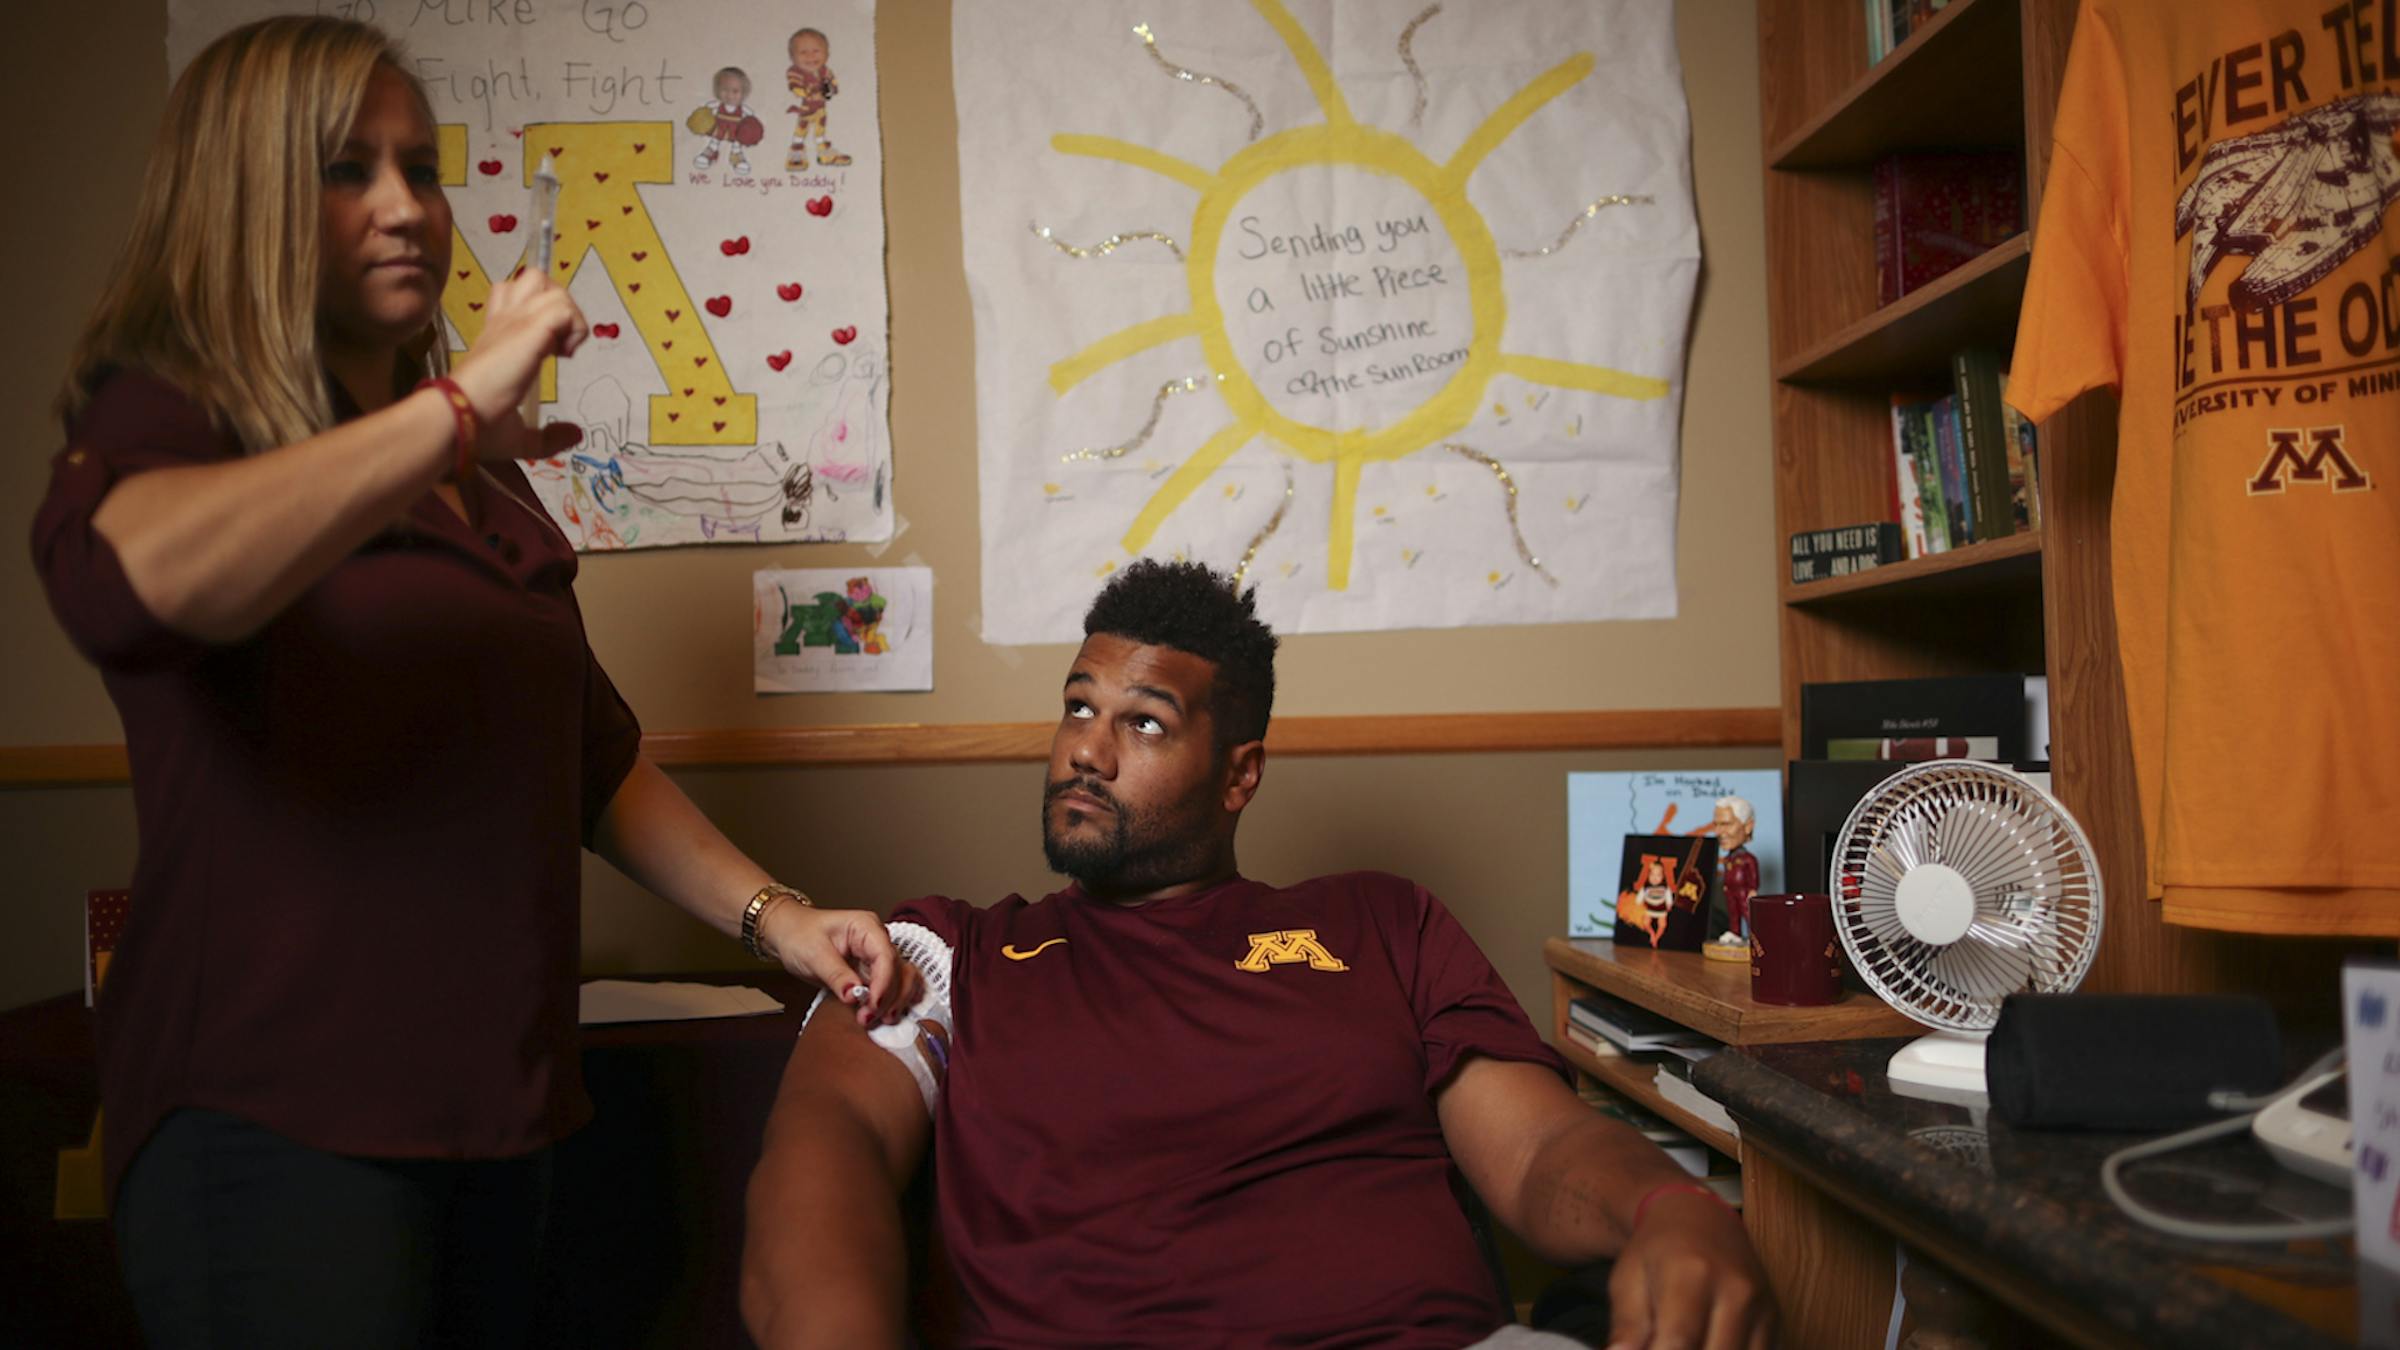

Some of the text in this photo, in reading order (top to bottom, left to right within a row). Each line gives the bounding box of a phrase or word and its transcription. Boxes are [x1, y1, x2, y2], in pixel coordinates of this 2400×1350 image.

[562, 59, 683, 115] Fight
[2172, 28, 2311, 184] EVER
[1238, 215, 1430, 260] Sending you
[1247, 287, 1275, 314] a
[1301, 271, 1364, 302] little
[1263, 320, 1438, 364] of Sunshine
[2201, 297, 2322, 375] THE
[2295, 382, 2338, 404] OF
[2348, 369, 2400, 398] MIN
[2246, 425, 2371, 496] M
[1792, 525, 1877, 556] ALL YOU NEED IS
[1235, 929, 1350, 973] M
